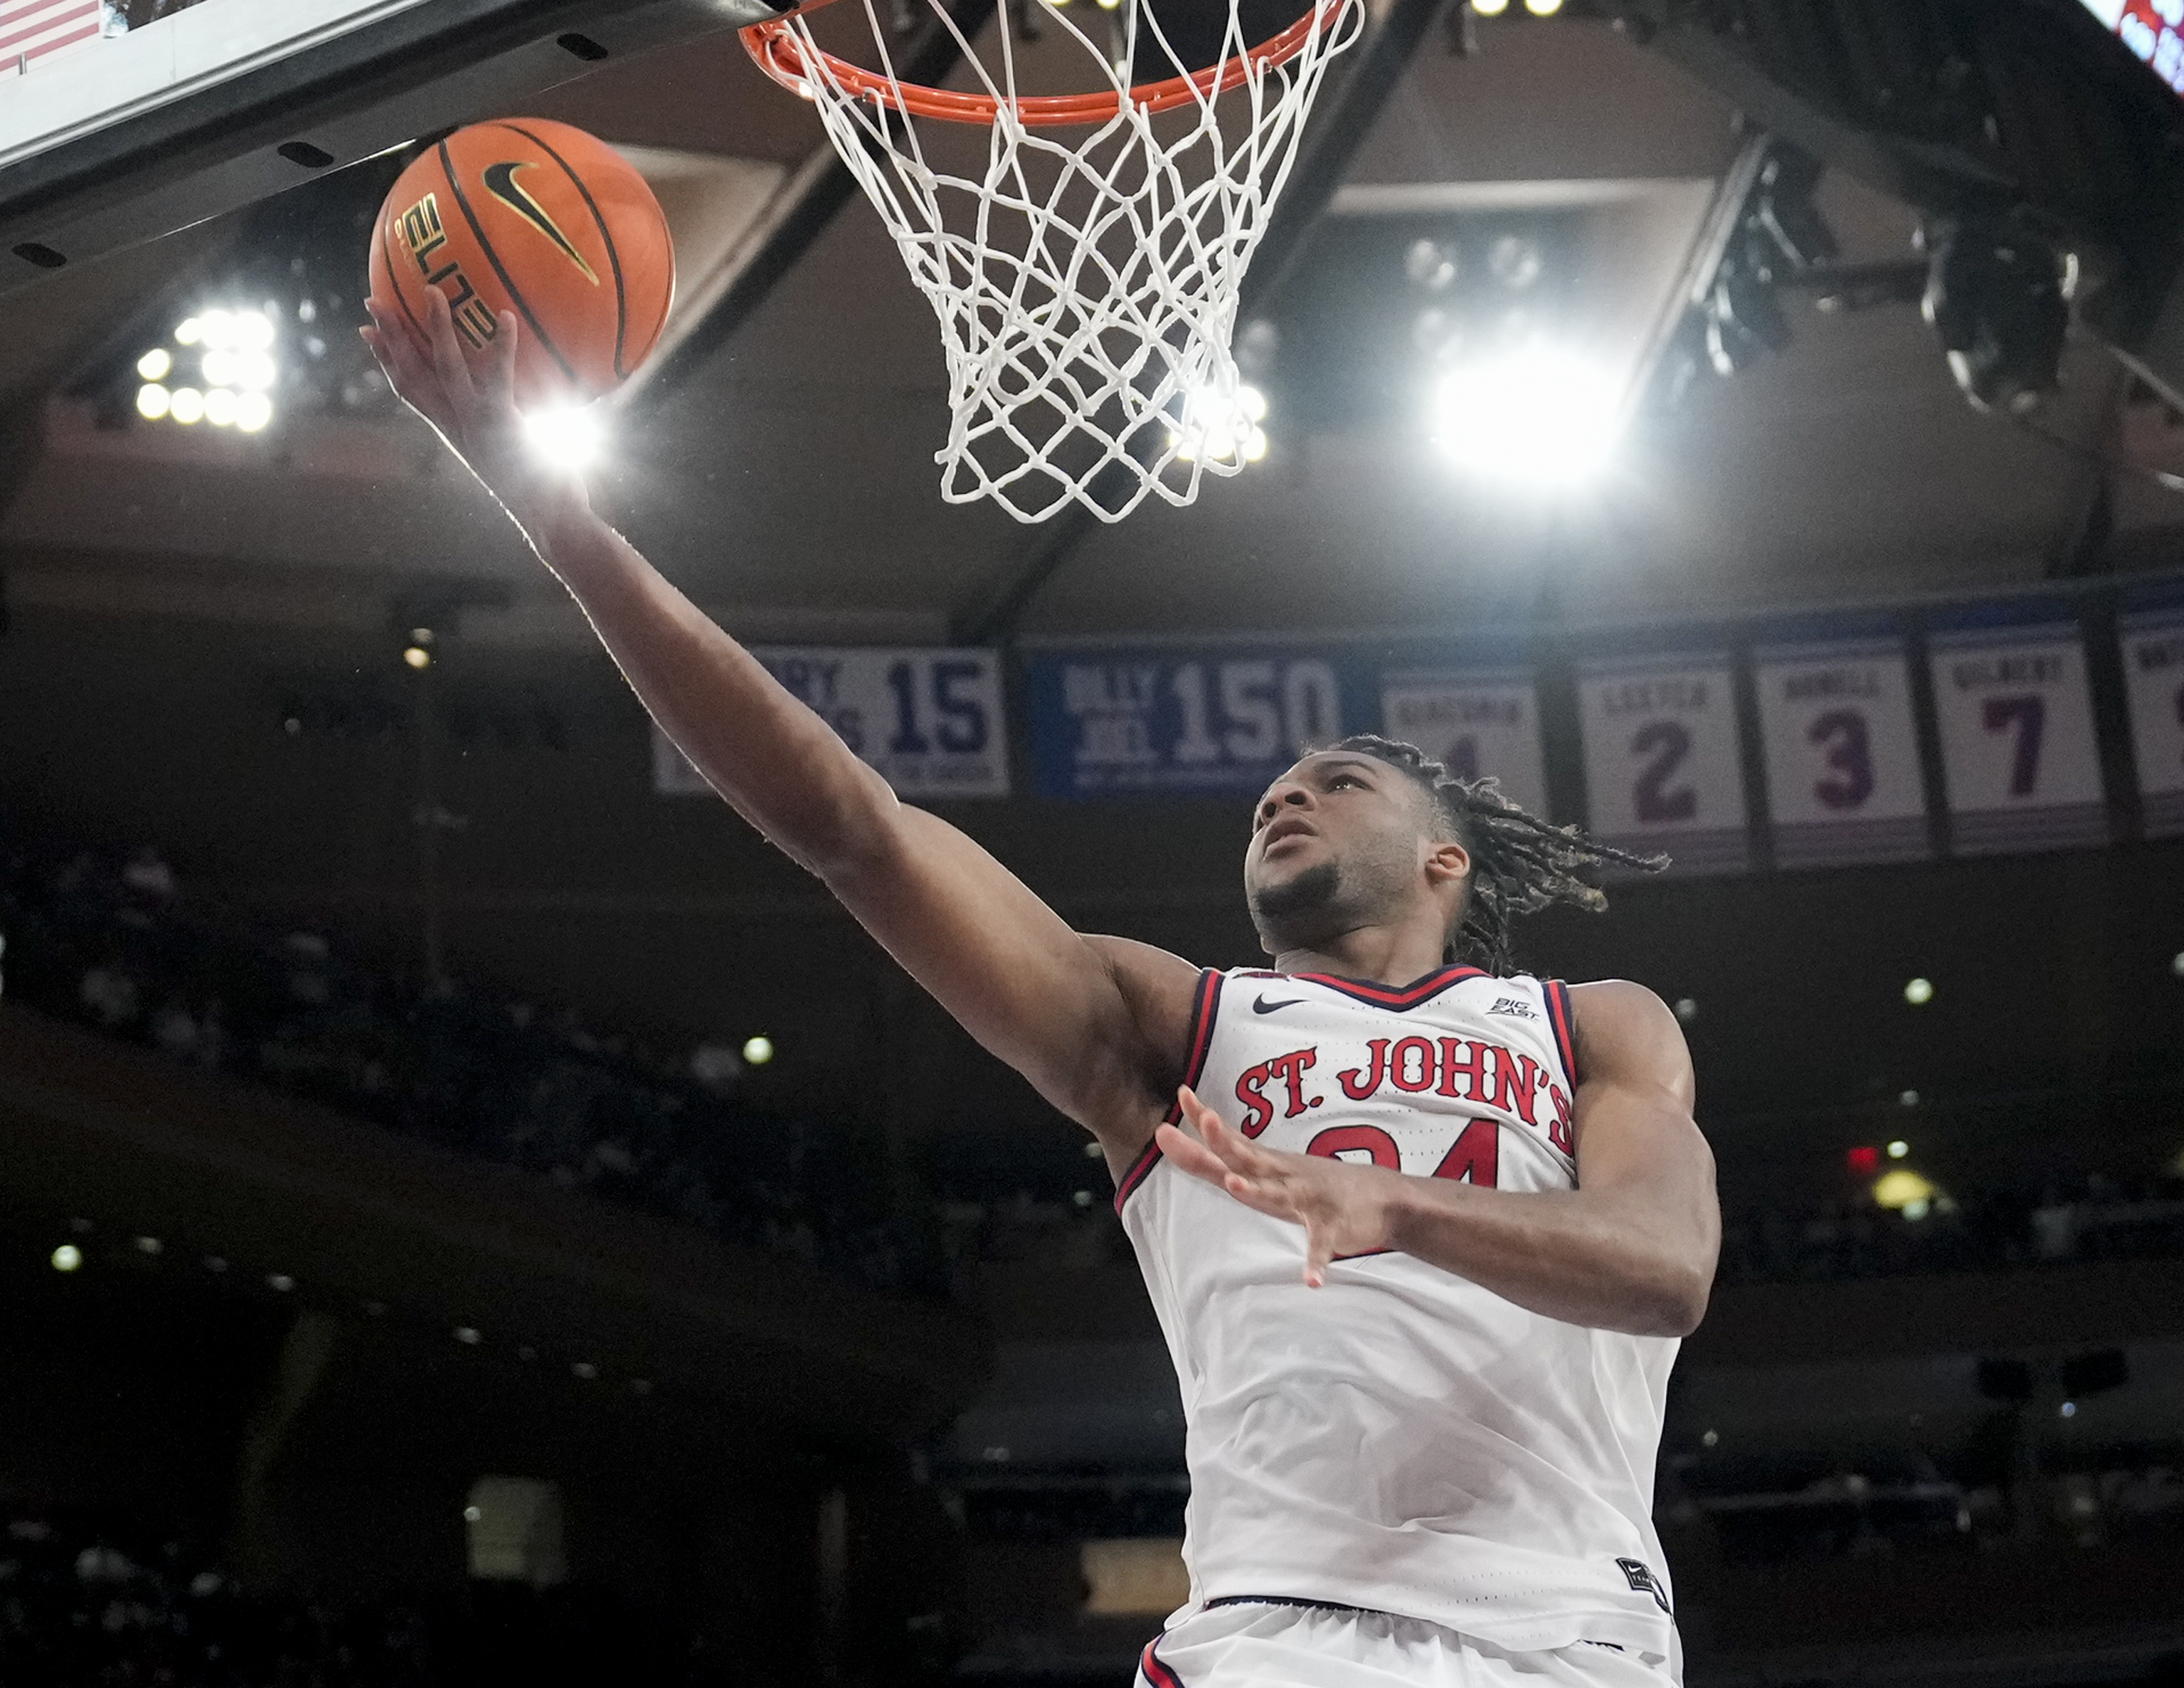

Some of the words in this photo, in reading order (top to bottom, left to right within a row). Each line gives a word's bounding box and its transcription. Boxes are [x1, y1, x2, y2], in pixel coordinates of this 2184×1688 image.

[401, 192, 499, 350] ELITE
[888, 660, 988, 754] 15
[1172, 661, 1342, 763] 150
[1981, 694, 2046, 797] 7
[1631, 721, 1698, 822] 2
[1807, 707, 1873, 810] 3
[1486, 1004, 1540, 1020] EAST
[1495, 997, 1530, 1009] BIG
[1235, 1045, 1324, 1139] ST.
[1336, 1035, 1574, 1157] JOHN'S
